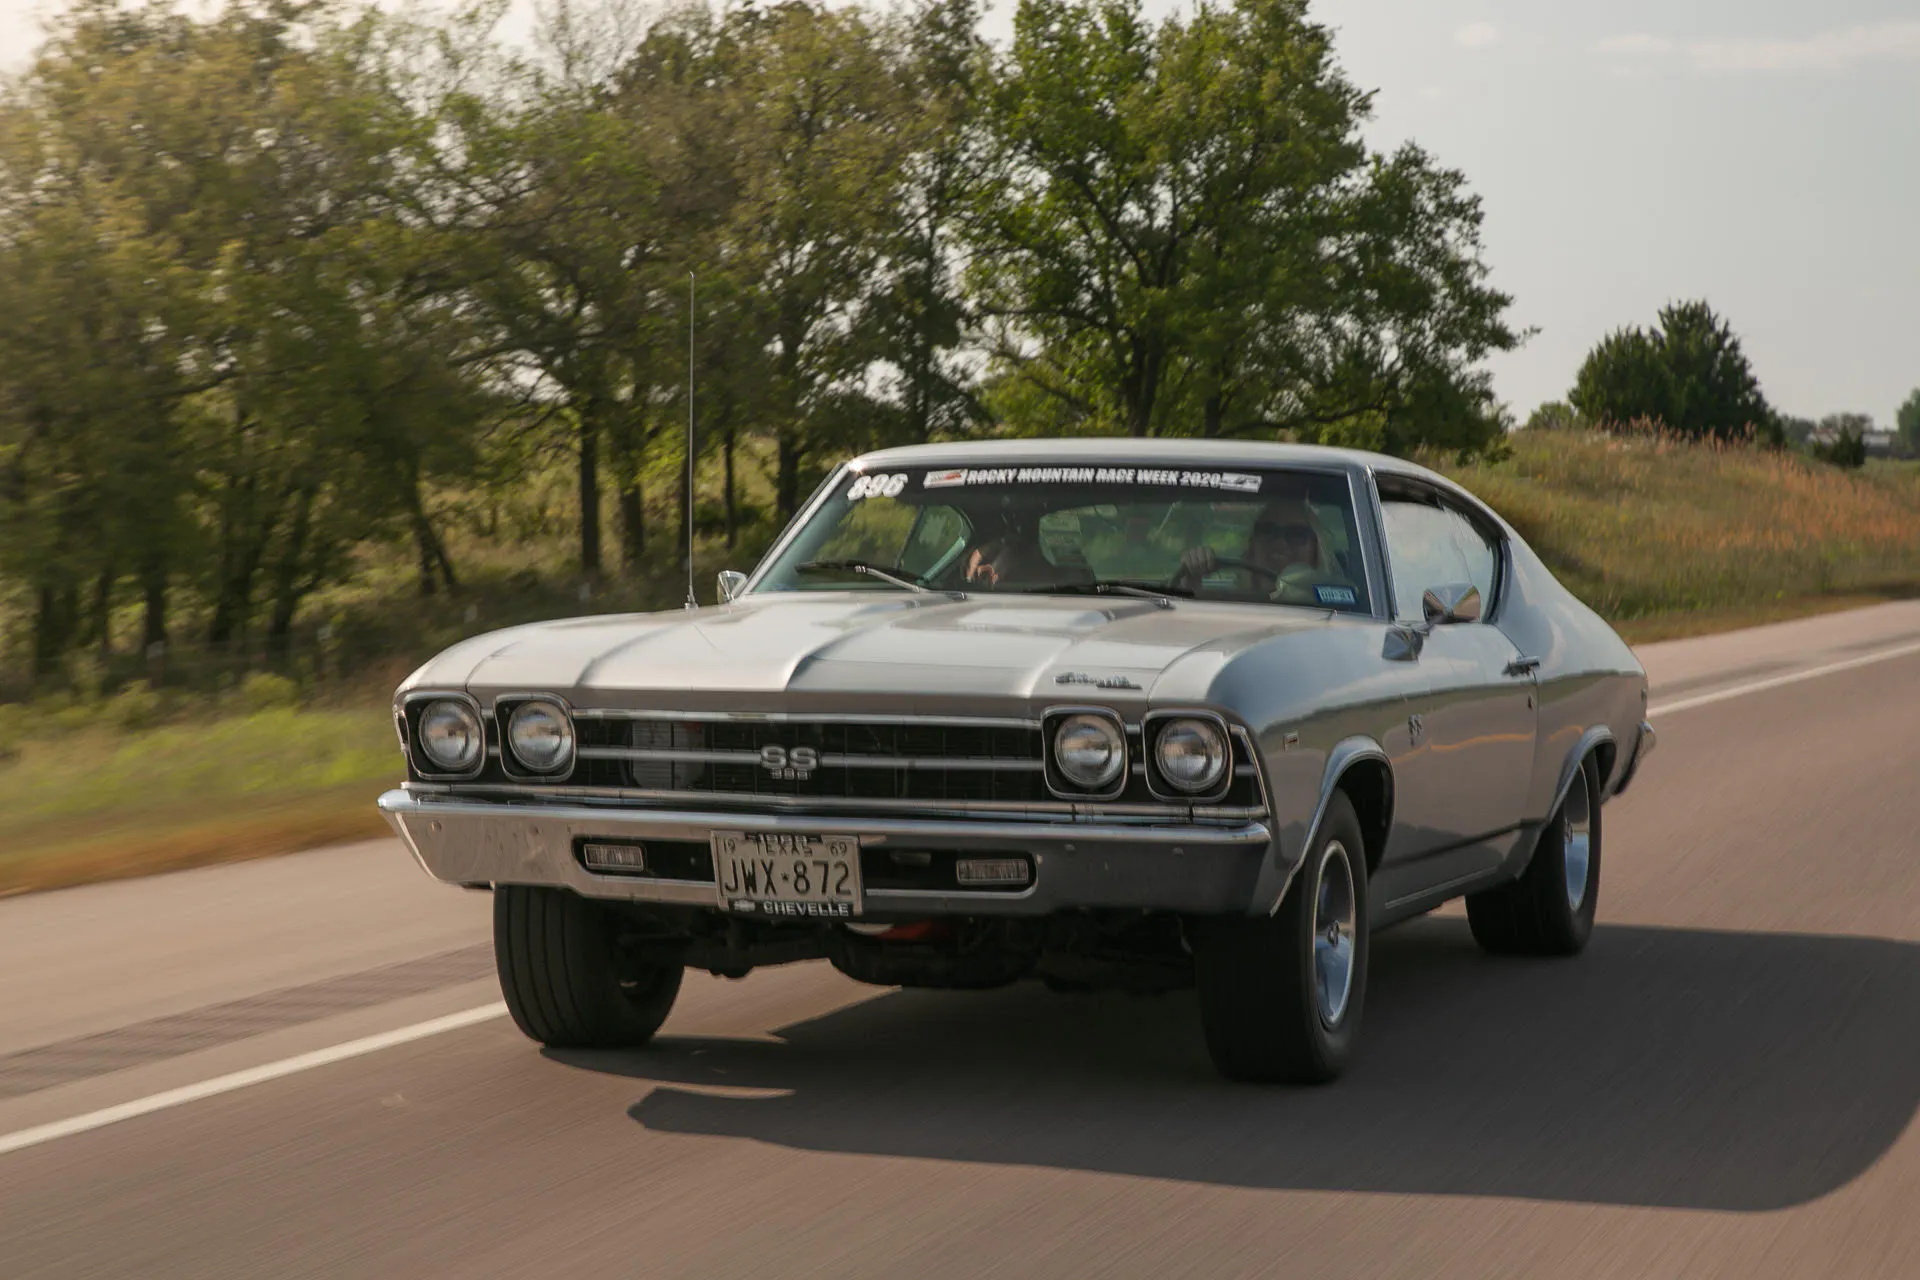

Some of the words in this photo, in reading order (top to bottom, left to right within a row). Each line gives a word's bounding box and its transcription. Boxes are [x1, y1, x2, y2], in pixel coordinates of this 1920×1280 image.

[967, 469, 1017, 484] ROCKY
[1017, 468, 1094, 483] MOUNTAIN
[1096, 468, 1135, 483] RACE
[1137, 469, 1180, 485] WEEK
[1180, 471, 1220, 488] 2020
[761, 745, 817, 769] SS
[723, 839, 736, 854] 19
[830, 841, 848, 856] 69
[763, 901, 849, 917] CHEVELLE
